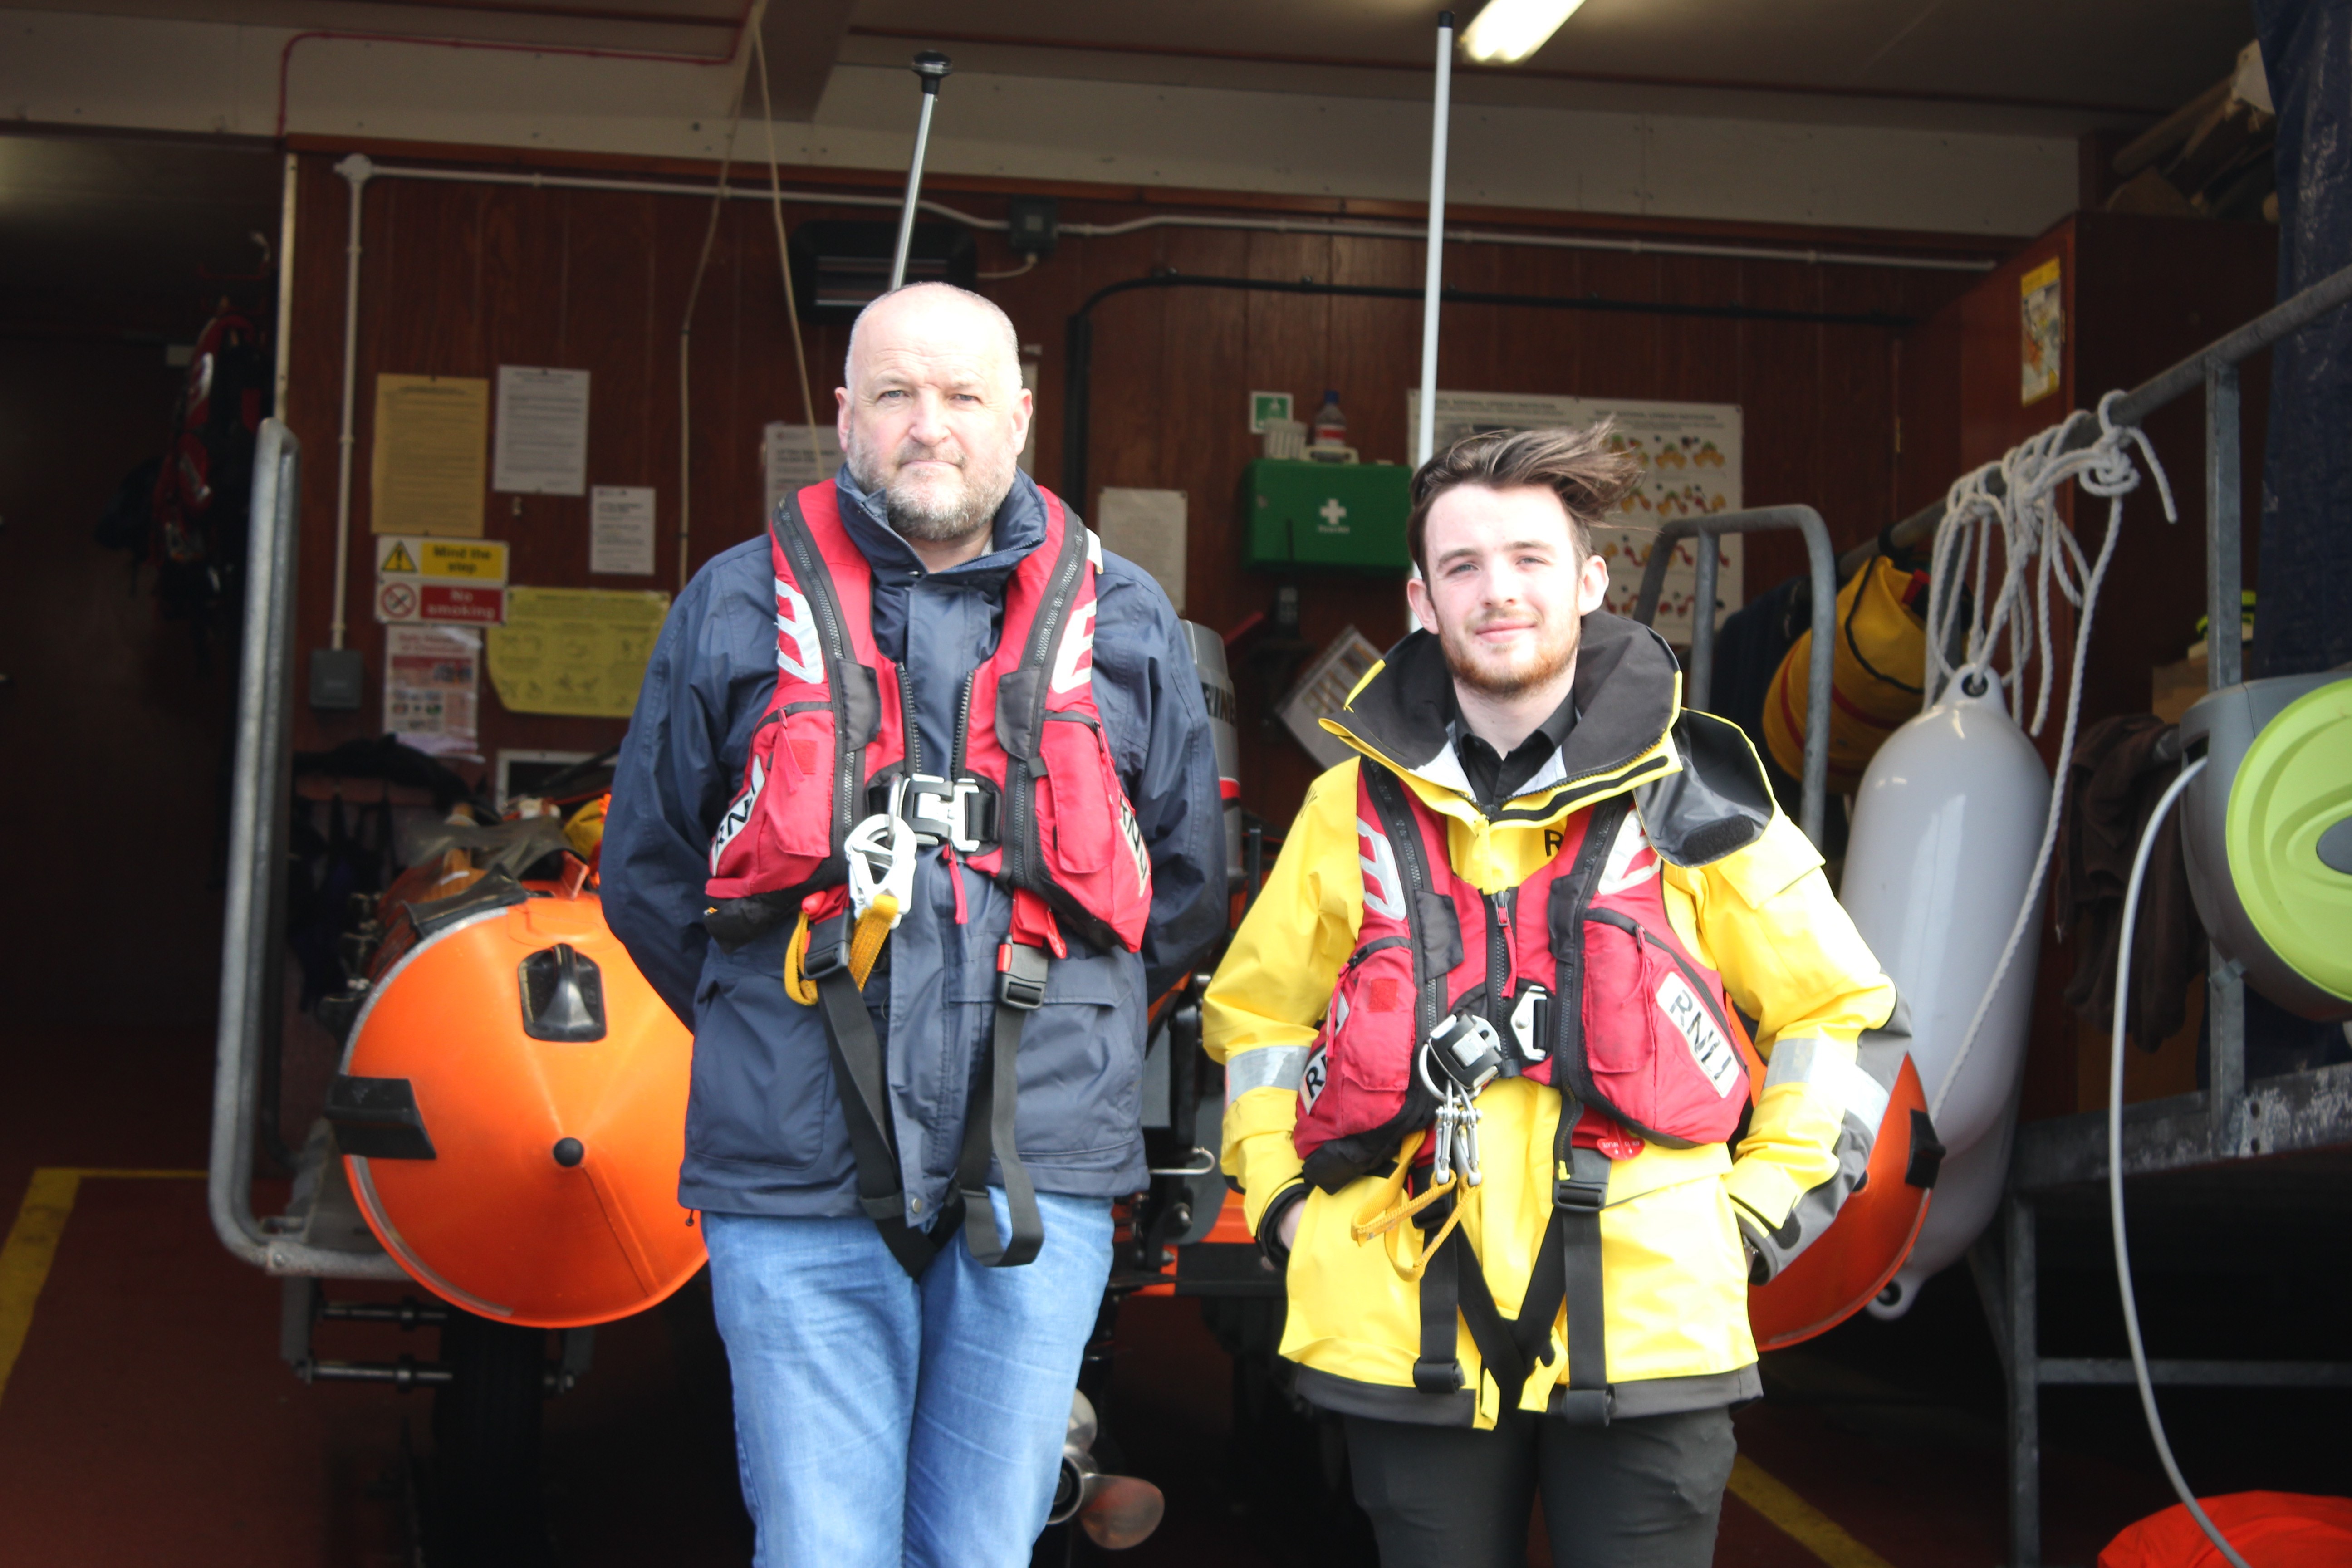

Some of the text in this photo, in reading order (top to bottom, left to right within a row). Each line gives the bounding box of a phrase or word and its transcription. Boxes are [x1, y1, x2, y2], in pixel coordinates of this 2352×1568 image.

[434, 546, 491, 559] Mind the
[448, 562, 476, 574] step
[450, 589, 473, 603] No
[426, 604, 495, 618] smoking
[1670, 988, 1732, 1081] RNLI
